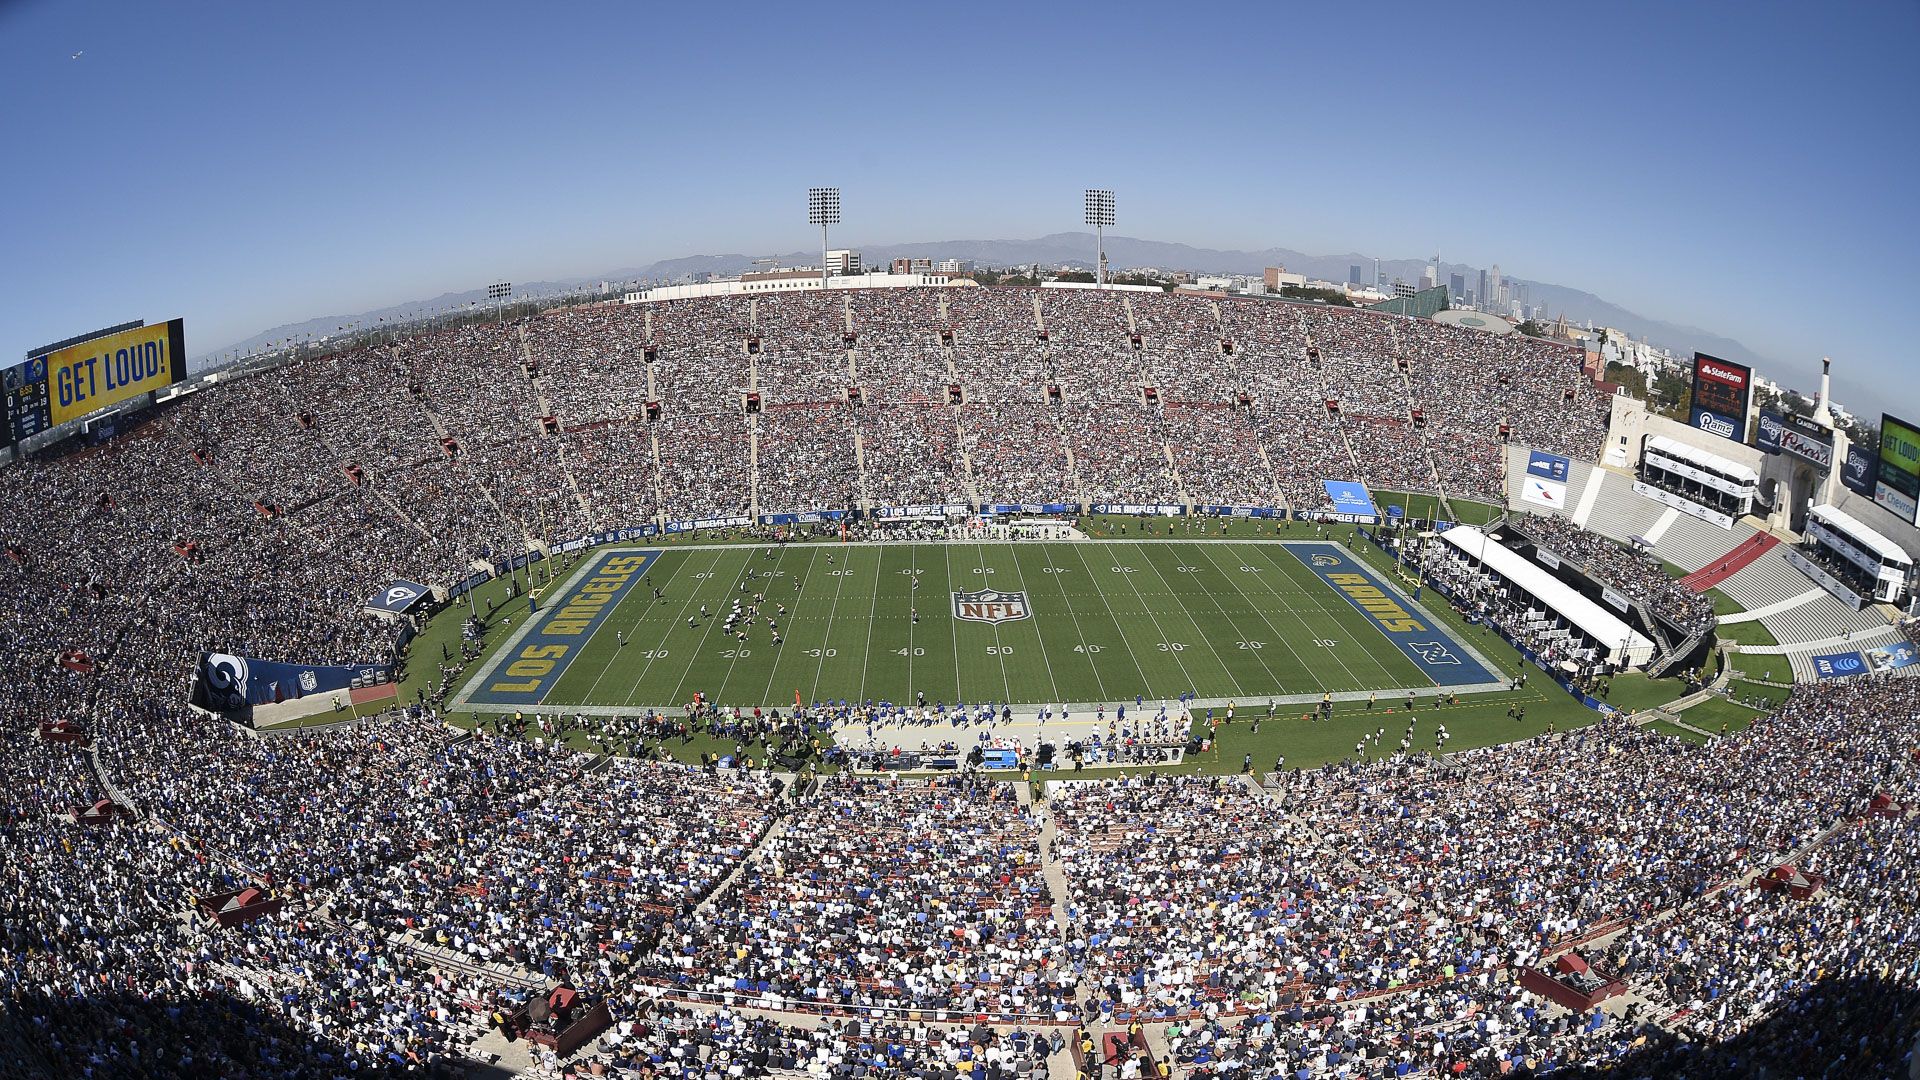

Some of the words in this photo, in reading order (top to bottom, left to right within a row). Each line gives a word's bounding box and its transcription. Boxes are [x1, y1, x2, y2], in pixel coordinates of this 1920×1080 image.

[57, 357, 97, 407] GET
[104, 338, 166, 391] LOUD!
[40, 384, 46, 395] 3
[7, 396, 14, 408] 0
[1700, 412, 1735, 438] Rams
[1884, 434, 1898, 452] GET
[1887, 492, 1915, 515] Chevron
[890, 507, 904, 516] LOS
[943, 505, 967, 515] RAMS
[1108, 505, 1122, 514] LOS
[1124, 505, 1156, 514] ANGELES
[1157, 505, 1181, 515] RAMS
[680, 521, 693, 530] LOS
[450, 586, 461, 598] LOS
[1325, 573, 1428, 632] RAMS
[963, 603, 1022, 619] NFL
[489, 644, 570, 693] LOS
[541, 556, 647, 635] ANGELES
[1073, 644, 1101, 653] 40
[1157, 642, 1184, 652] 30
[1236, 641, 1263, 650] 20
[1312, 639, 1336, 647] 10
[647, 649, 669, 659] 10
[723, 650, 751, 658] 20
[809, 649, 837, 658] 30
[897, 647, 925, 657] 40
[986, 646, 1014, 655] 50
[1817, 659, 1834, 674] AT&T
